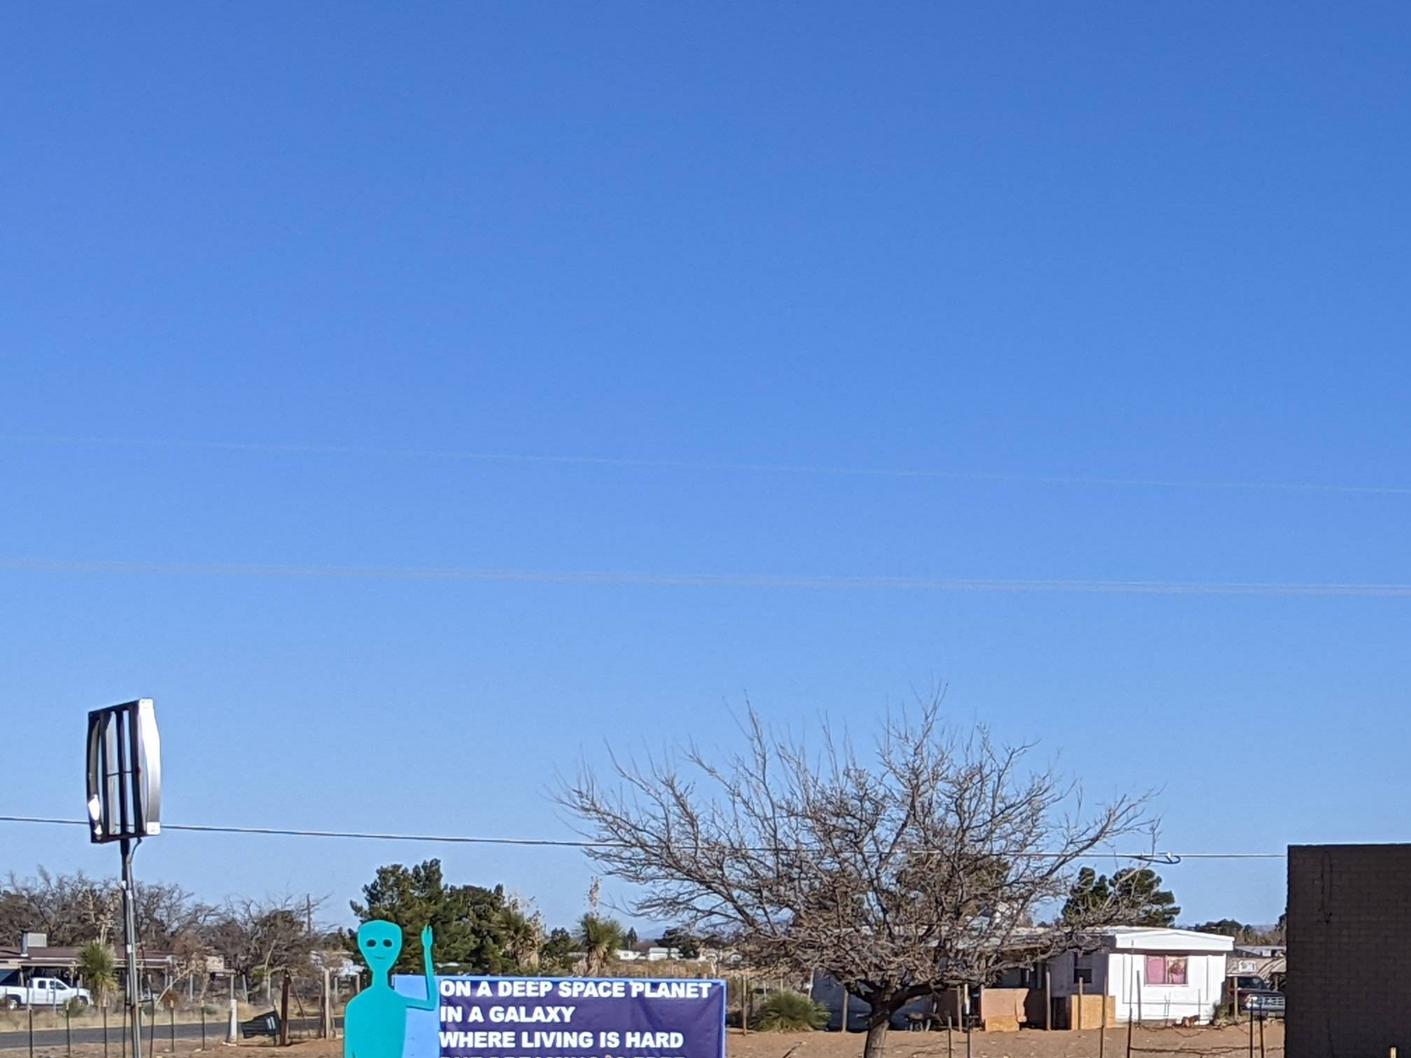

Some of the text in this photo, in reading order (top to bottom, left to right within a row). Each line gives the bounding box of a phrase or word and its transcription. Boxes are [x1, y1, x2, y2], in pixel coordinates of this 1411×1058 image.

[440, 980, 713, 999] ON A DEEP SPACE PLANET
[439, 1006, 576, 1023] IN A GALAXY
[438, 1031, 684, 1049] WHERE LIVING IS HARD
